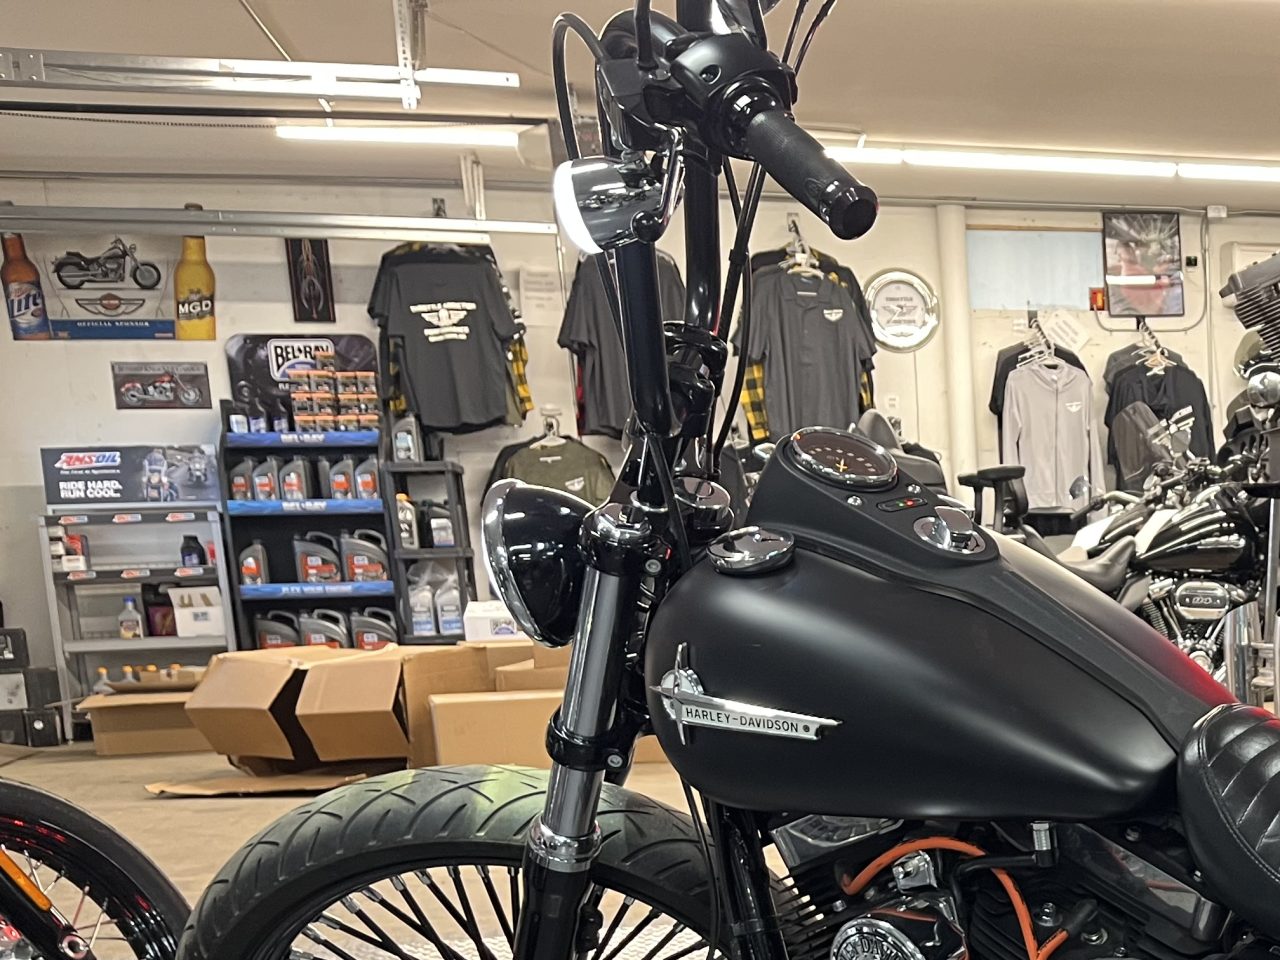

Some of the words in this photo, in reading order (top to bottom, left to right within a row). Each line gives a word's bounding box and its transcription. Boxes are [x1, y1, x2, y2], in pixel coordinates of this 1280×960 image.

[178, 300, 213, 315] MGD
[76, 320, 113, 328] OFFICIAL
[62, 453, 119, 468] AMSOIL
[59, 480, 86, 490] RIDE
[60, 489, 86, 499] RUN
[685, 706, 800, 734] HARLEY-DAVIDSON
